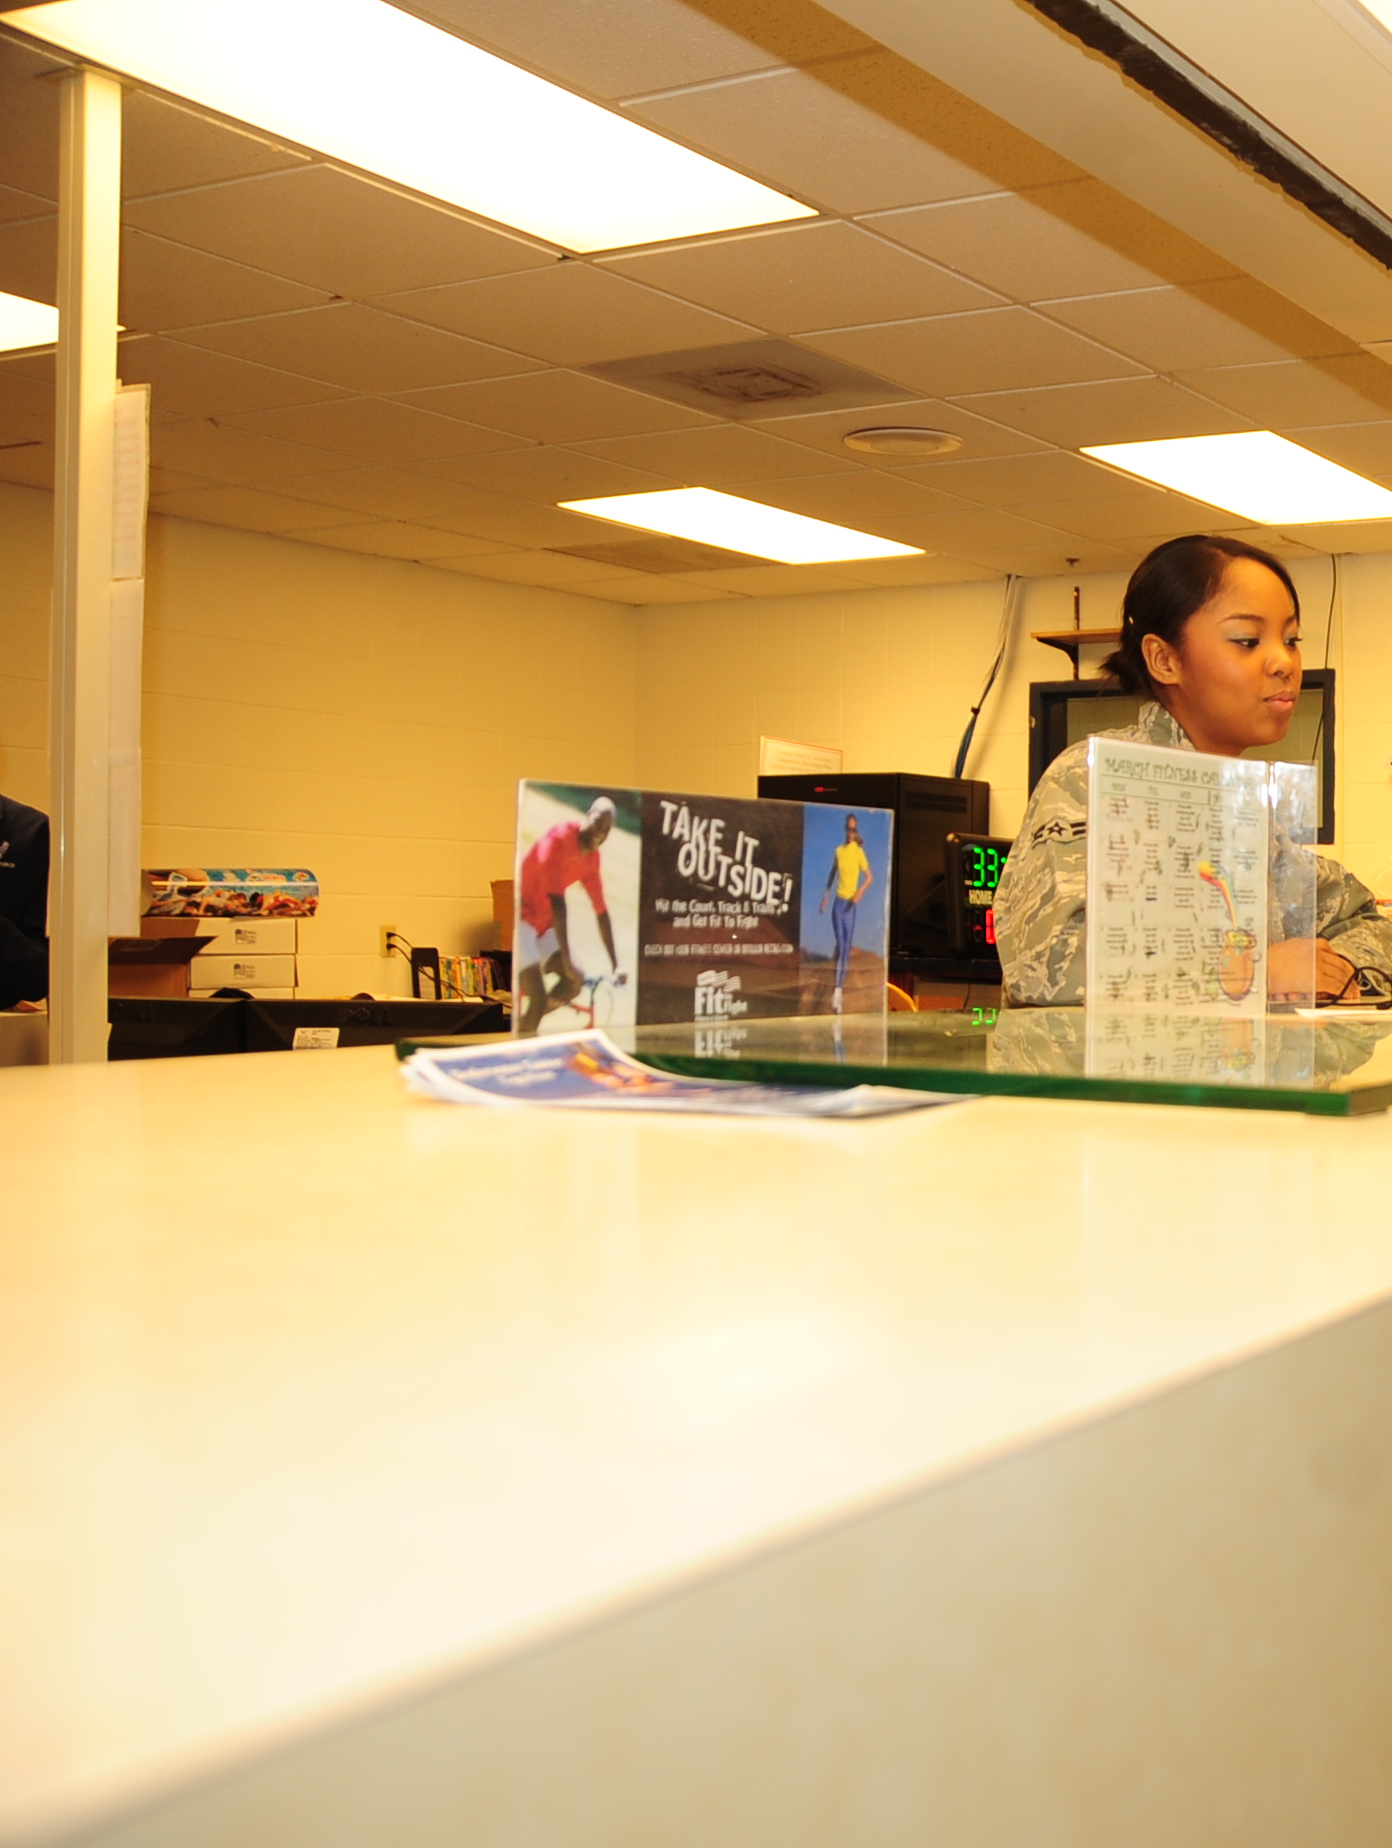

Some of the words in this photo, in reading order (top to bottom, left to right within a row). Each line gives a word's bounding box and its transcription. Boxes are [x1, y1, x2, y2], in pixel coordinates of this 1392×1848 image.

[1104, 757, 1151, 779] MARCH
[1153, 763, 1199, 783] FITNESS
[660, 800, 726, 854] TAKE
[735, 830, 760, 869] IT
[678, 842, 793, 913] OUTSIDE!
[718, 901, 742, 914] Track
[969, 889, 993, 905] HOME
[673, 915, 691, 928] and
[692, 914, 708, 928] Get
[709, 914, 722, 929] Fit
[724, 915, 735, 929] To
[694, 986, 724, 1015] Fit
